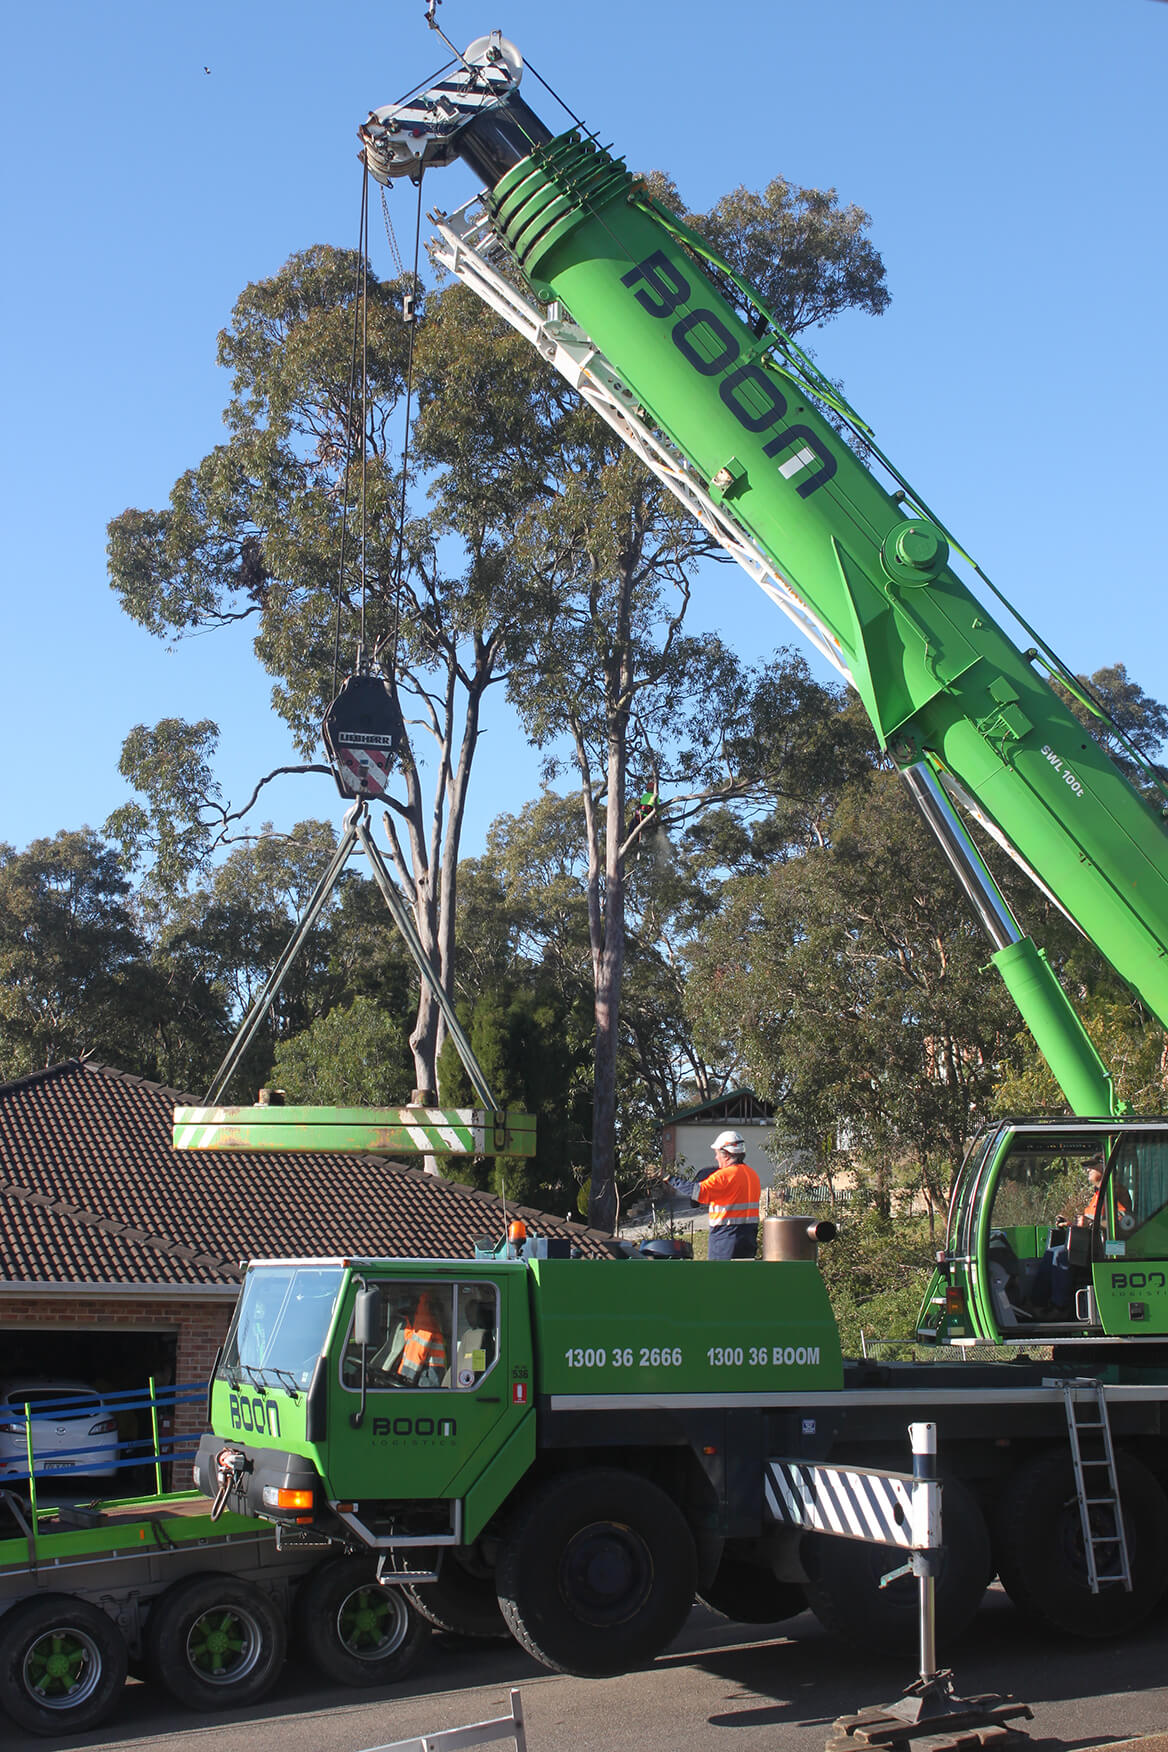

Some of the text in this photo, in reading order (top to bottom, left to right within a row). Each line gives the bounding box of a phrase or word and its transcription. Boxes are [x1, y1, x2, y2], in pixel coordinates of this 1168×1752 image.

[340, 733, 390, 744] LIEBHERR
[1041, 745, 1084, 797] SWL 100t
[565, 1347, 820, 1367] 1300 36 2666 1300 36 BOOM
